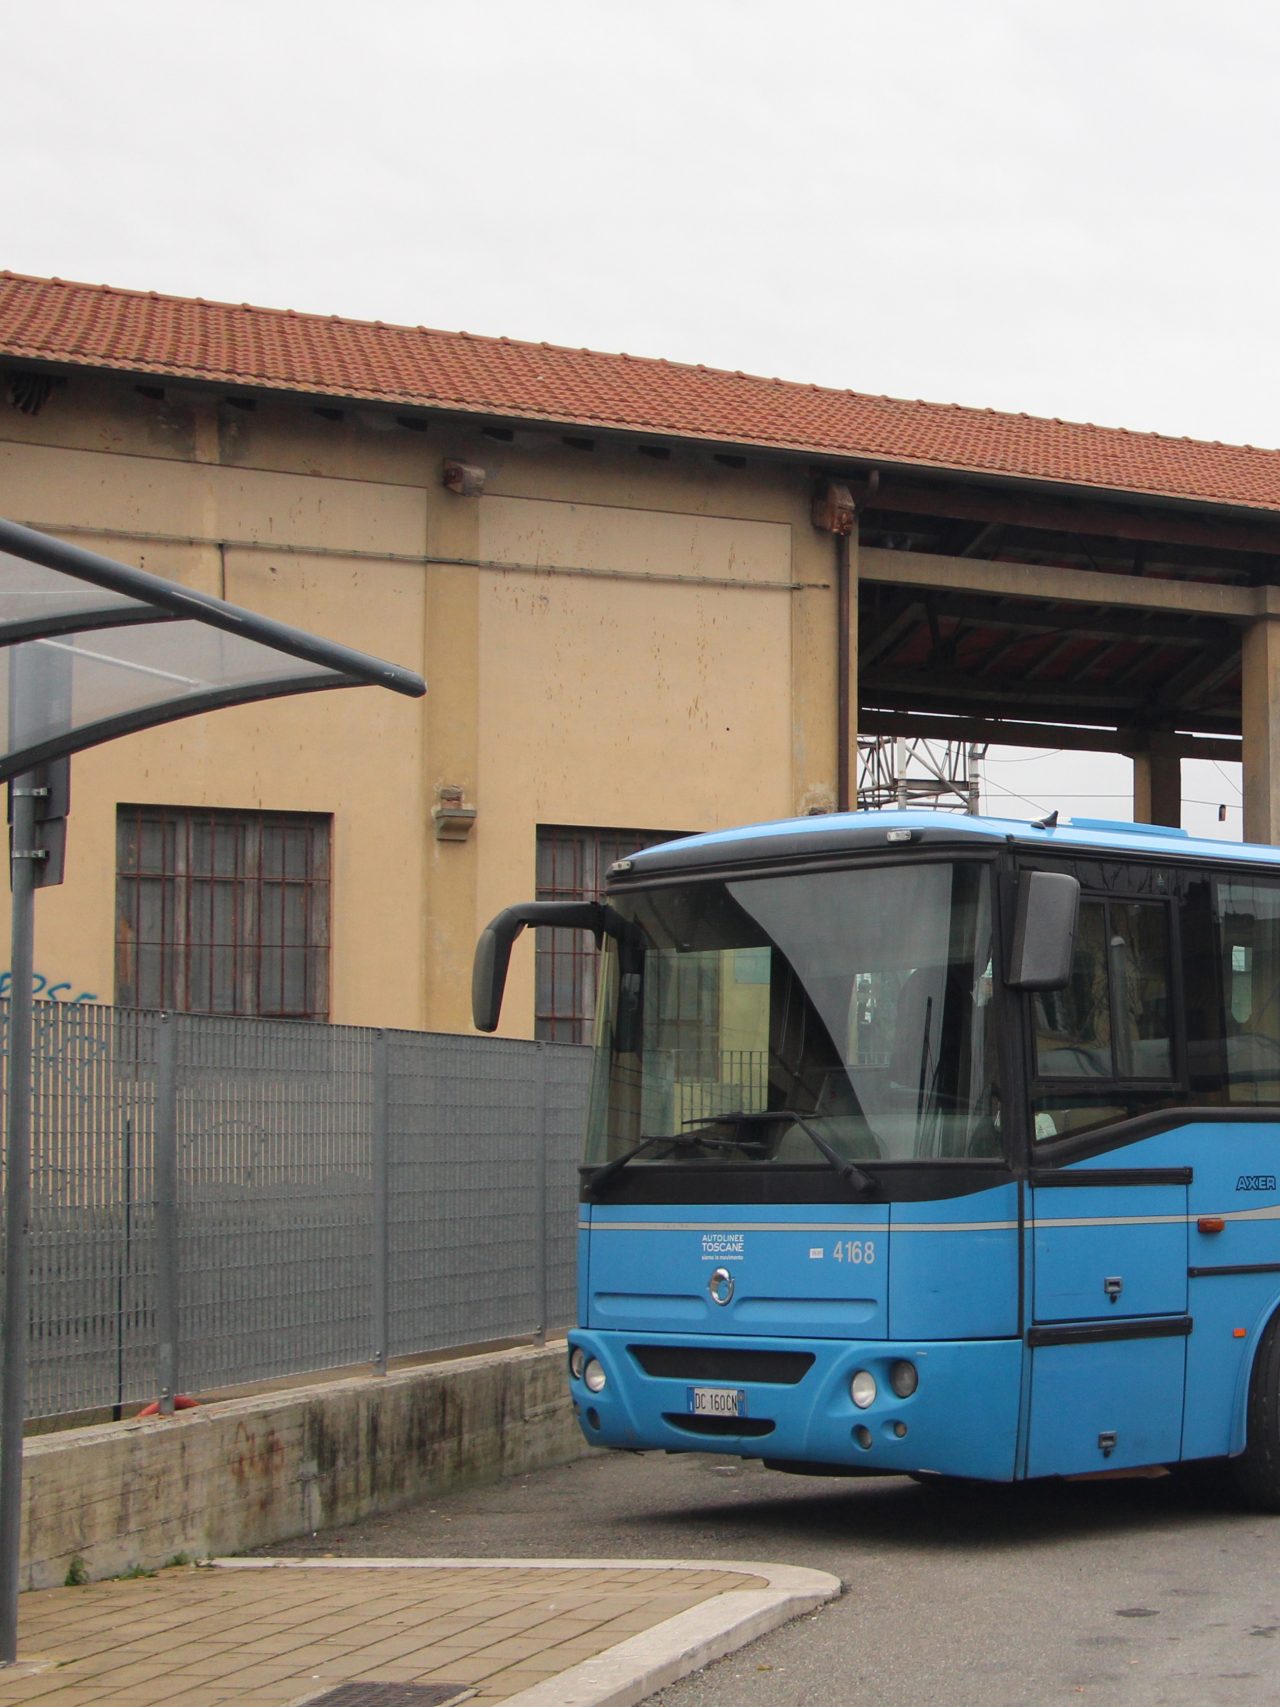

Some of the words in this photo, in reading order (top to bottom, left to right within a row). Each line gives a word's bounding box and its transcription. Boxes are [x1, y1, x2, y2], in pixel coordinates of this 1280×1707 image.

[1235, 1175, 1277, 1192] AXER
[701, 1234, 744, 1242] AUTOLINEE
[701, 1242, 744, 1252] TOSCANE
[832, 1241, 875, 1265] 4168
[695, 1393, 706, 1409] DC
